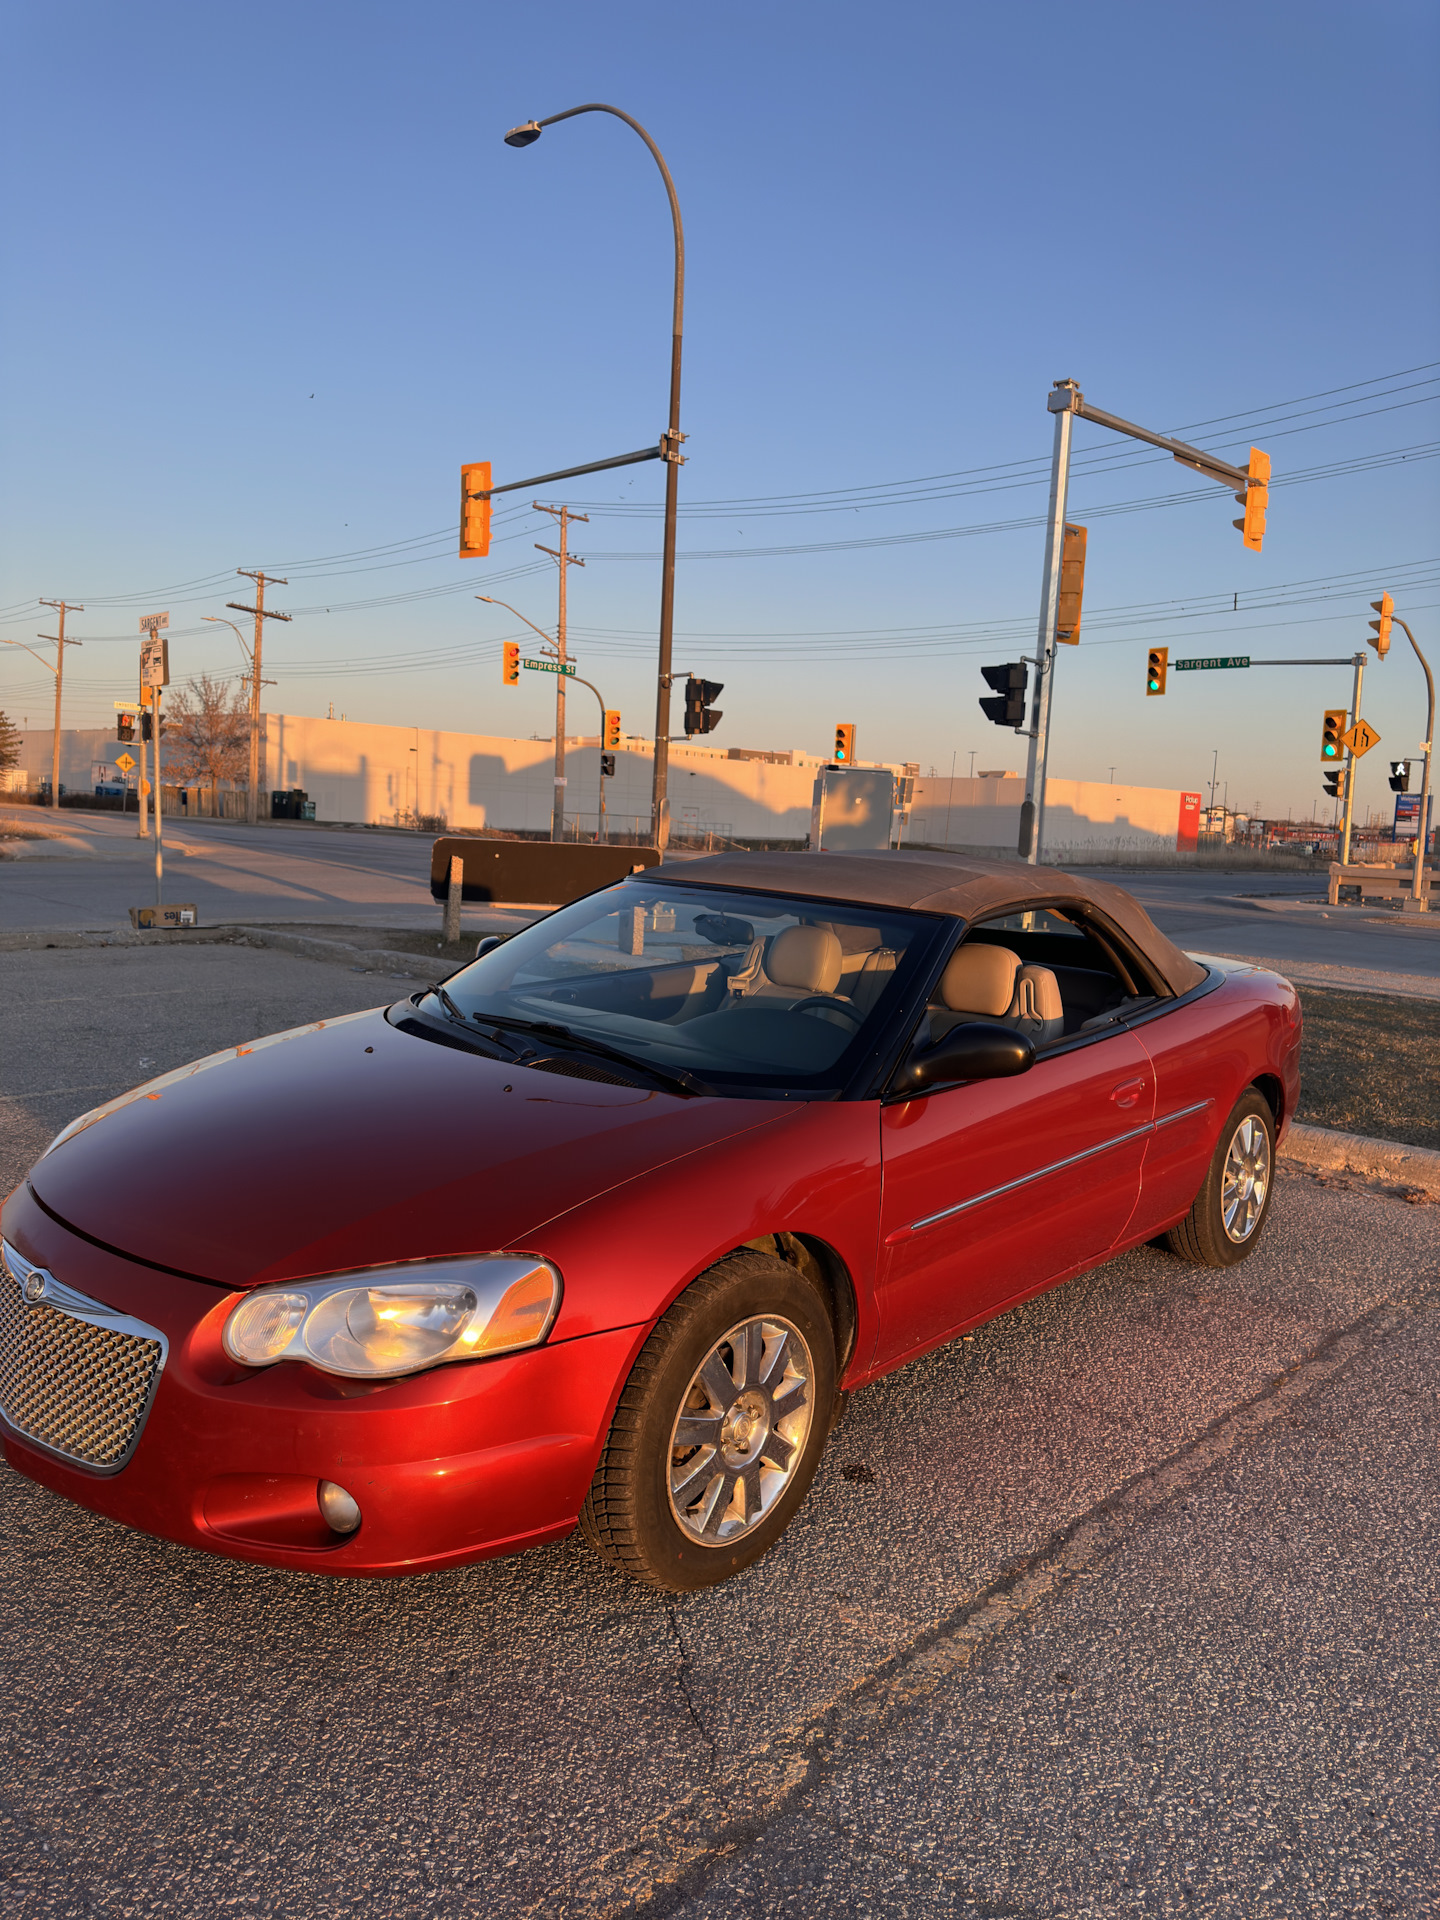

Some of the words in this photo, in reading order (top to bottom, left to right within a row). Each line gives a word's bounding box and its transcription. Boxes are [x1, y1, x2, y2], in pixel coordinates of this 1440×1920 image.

[141, 615, 162, 631] SARGENT
[525, 659, 562, 672] Empress
[566, 665, 575, 674] St
[1177, 659, 1221, 670] Sargent
[1227, 657, 1249, 667] Ave
